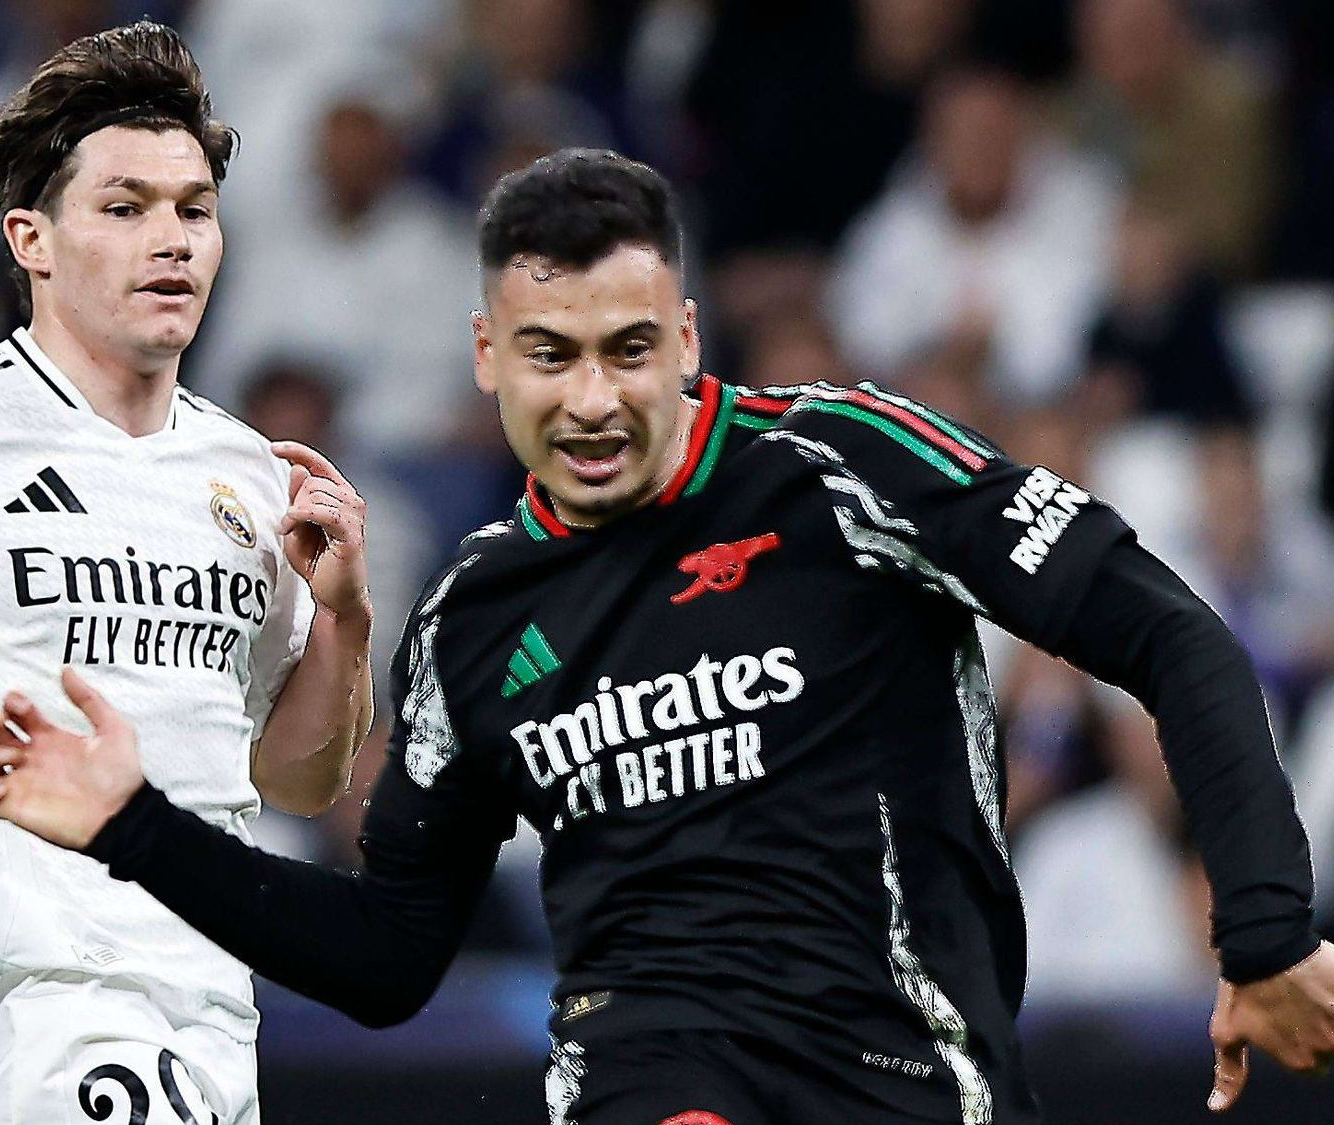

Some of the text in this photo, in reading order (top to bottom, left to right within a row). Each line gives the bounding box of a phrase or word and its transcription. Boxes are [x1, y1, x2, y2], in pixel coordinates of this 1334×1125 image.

[7, 546, 267, 626] Emirates
[63, 616, 241, 673] FLY BETTER
[511, 646, 806, 790] Emirates
[553, 722, 766, 831] LY BETTER
